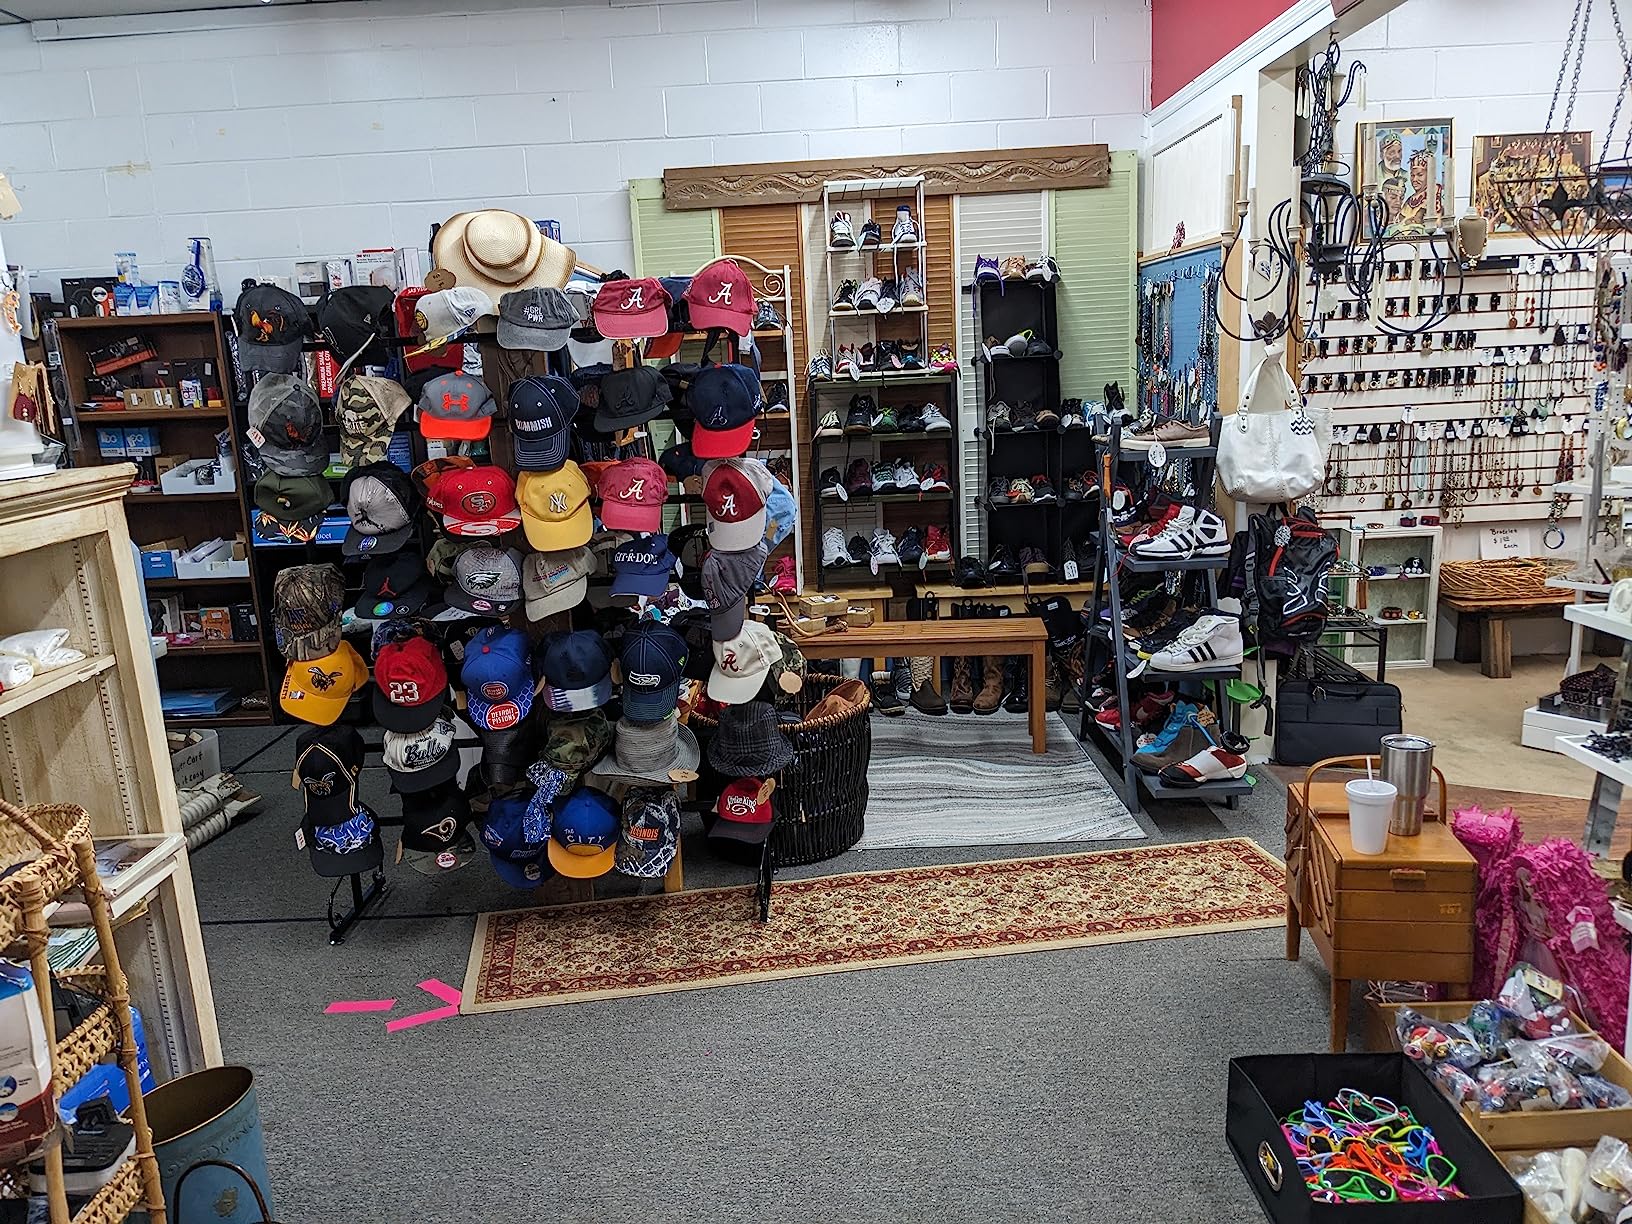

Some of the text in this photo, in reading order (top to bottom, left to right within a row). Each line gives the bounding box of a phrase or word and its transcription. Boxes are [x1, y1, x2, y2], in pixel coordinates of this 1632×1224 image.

[620, 286, 645, 310] A
[708, 281, 734, 305] A
[619, 478, 645, 501] A
[715, 493, 739, 517] A
[388, 681, 420, 703] 23
[491, 708, 514, 719] DETROIT
[492, 715, 516, 726] PISTONS
[566, 834, 606, 845] CITY
[629, 825, 660, 841] ILLINOIS
